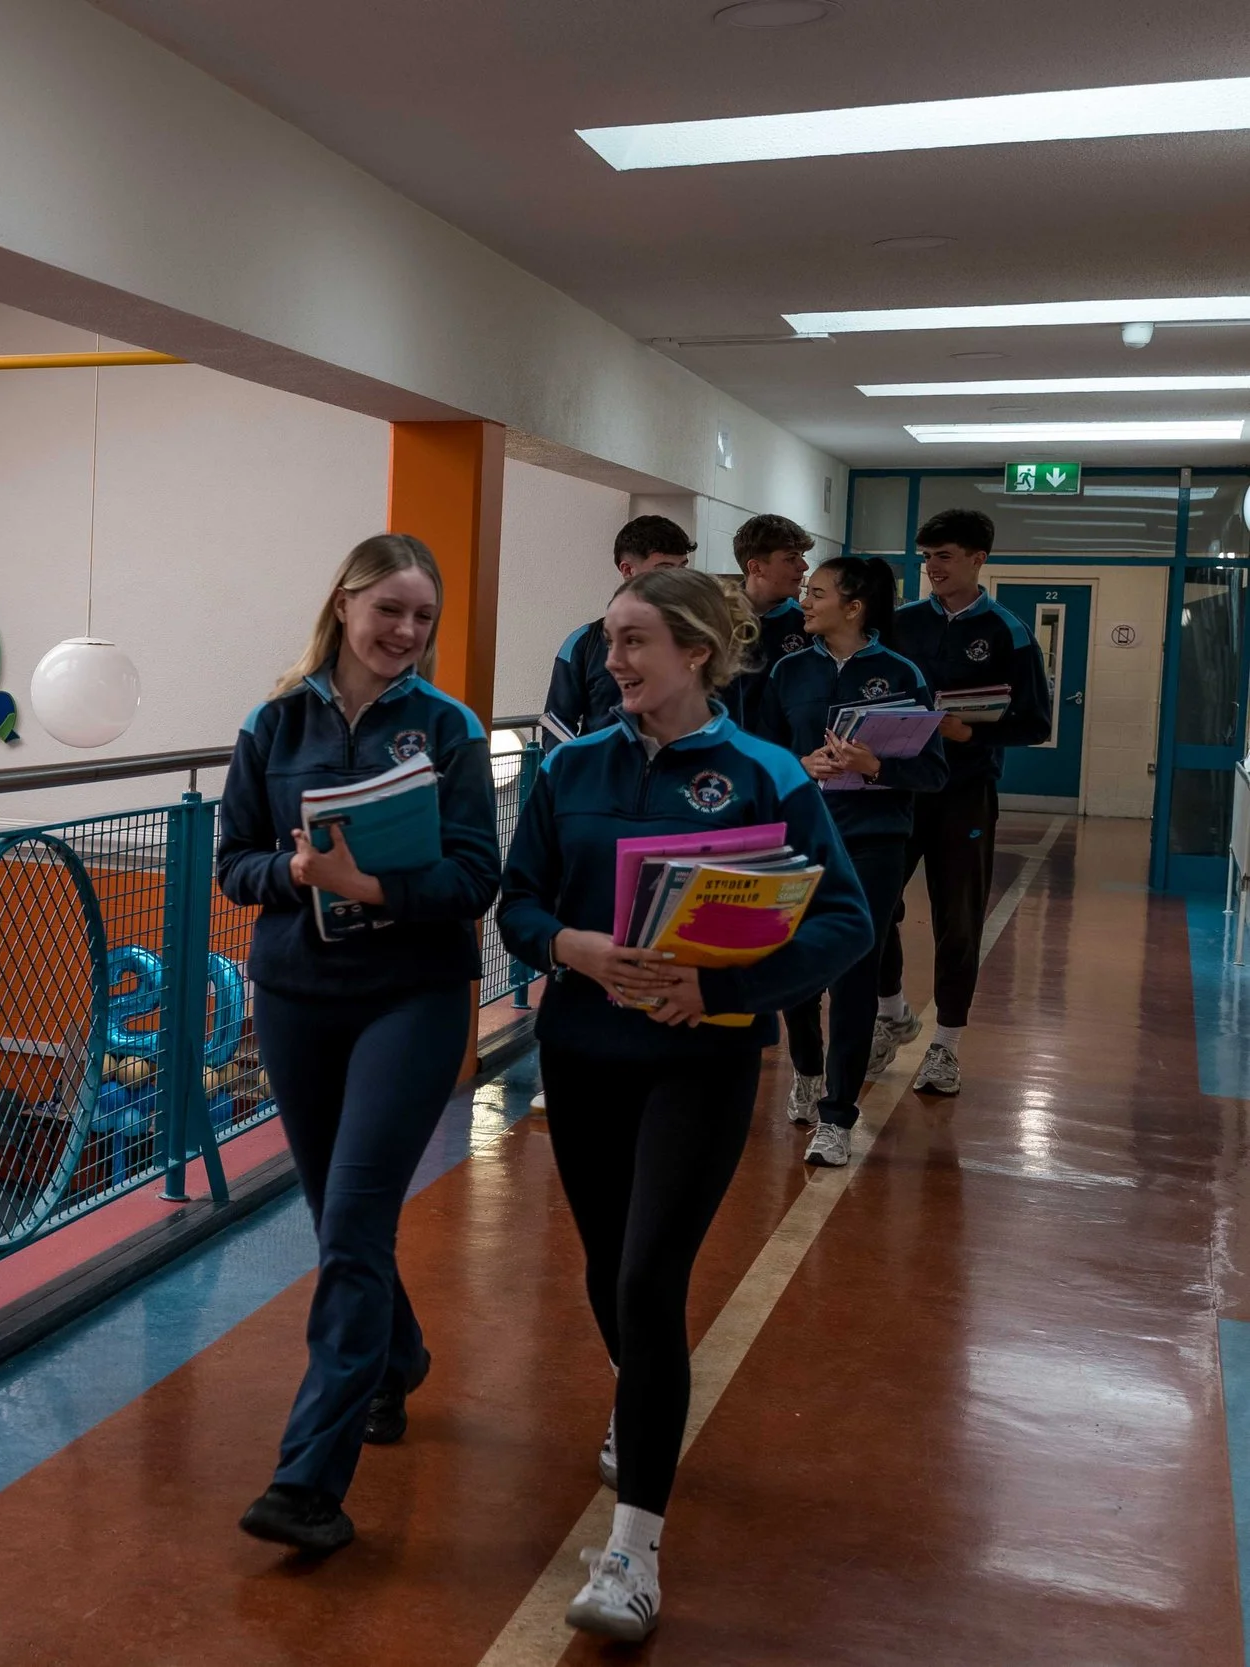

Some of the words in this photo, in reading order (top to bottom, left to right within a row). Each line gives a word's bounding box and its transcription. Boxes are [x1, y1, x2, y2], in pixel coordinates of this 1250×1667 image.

[1045, 591, 1058, 600] 22
[705, 879, 759, 890] STUDENT
[695, 892, 760, 904] PORTFOLIO
